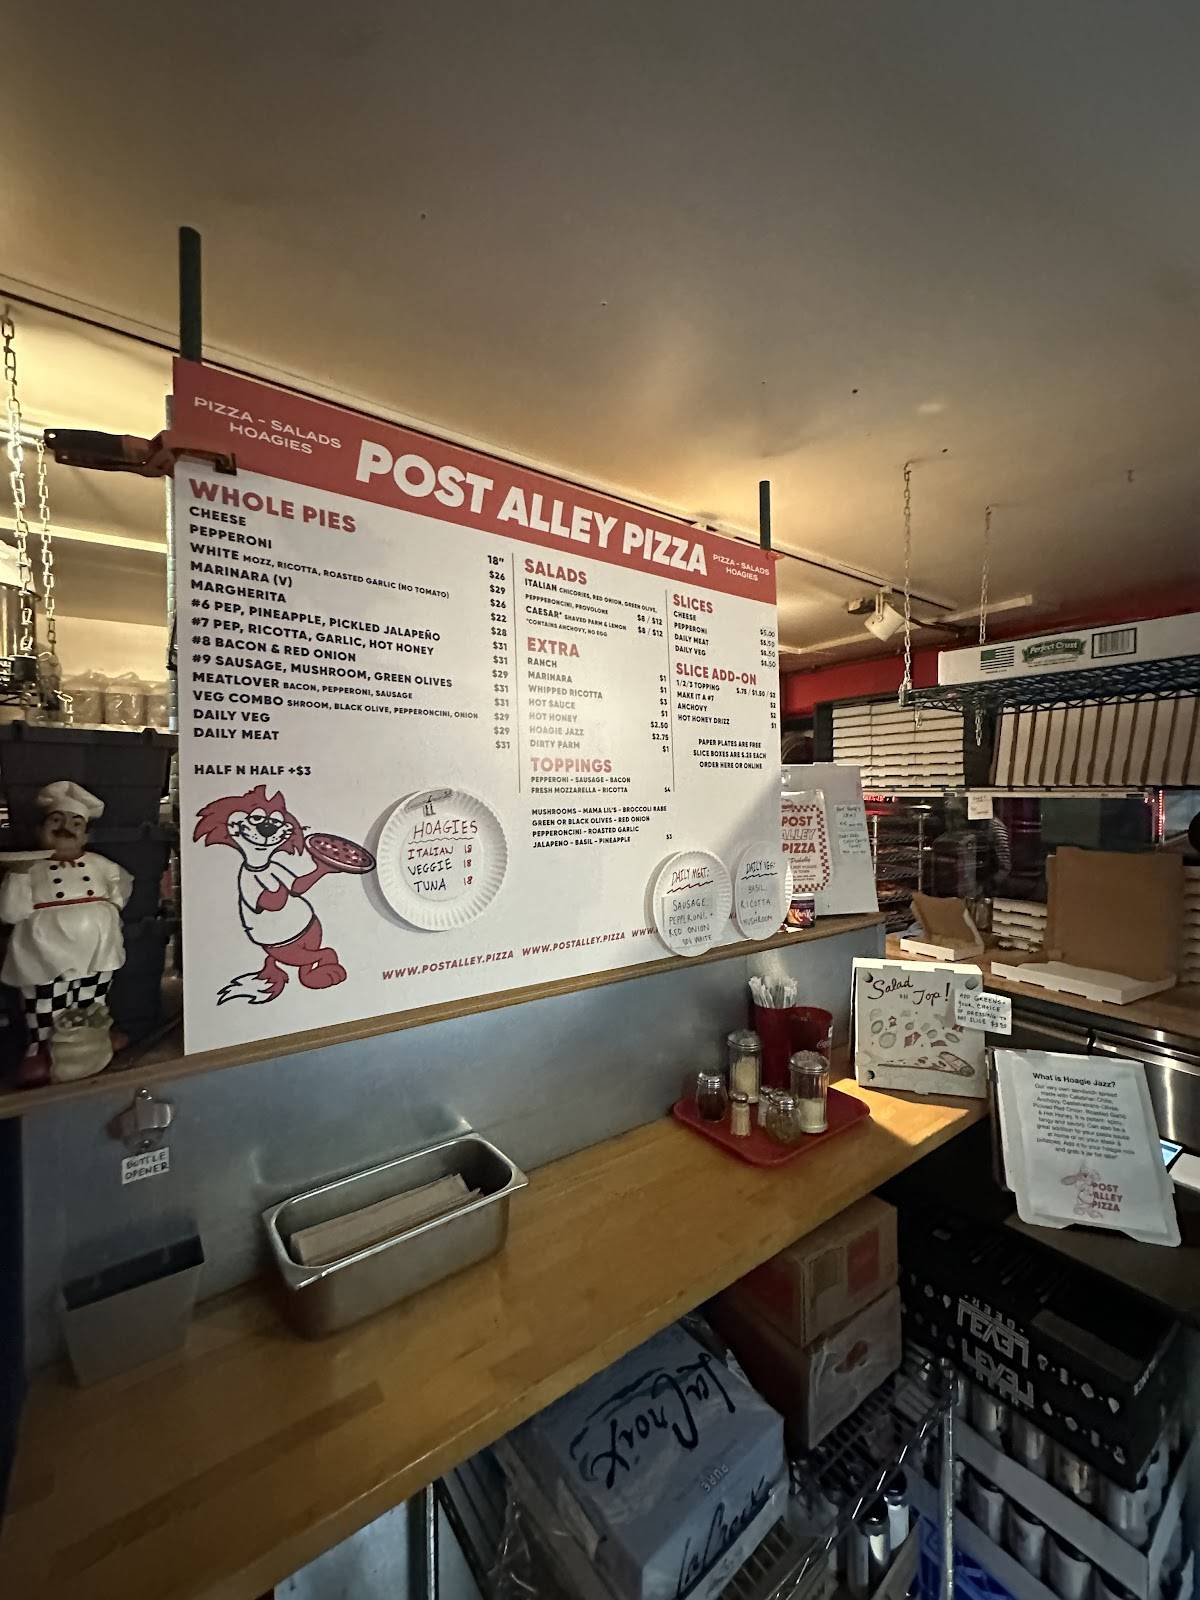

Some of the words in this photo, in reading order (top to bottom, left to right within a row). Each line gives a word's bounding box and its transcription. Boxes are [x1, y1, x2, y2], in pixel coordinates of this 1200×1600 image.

[194, 396, 252, 422] PIZZA
[271, 420, 342, 449] SALADS
[230, 422, 313, 454] HOAGIES
[189, 479, 294, 520] WHOLE
[303, 506, 357, 533] PIES
[356, 439, 493, 513] POST
[498, 486, 620, 548] ALLEY
[622, 522, 708, 577] PIZZA
[190, 506, 246, 526] CHEESE
[190, 524, 272, 549] PEPPERONI
[190, 542, 239, 560] WHITE
[277, 561, 321, 576] RICOTTA,
[323, 570, 363, 583] ROASTED
[366, 578, 396, 589] GARLIC
[524, 558, 587, 585] SALADS
[713, 554, 735, 566] PIZZA
[741, 563, 770, 576] SALADS
[191, 561, 269, 583] MARINARA
[274, 575, 293, 587] (V)
[489, 571, 505, 581] $26
[726, 567, 758, 581] HOAGIES
[191, 579, 286, 603] MARGHERITA
[490, 585, 505, 595] $29
[525, 578, 557, 591] ITALIAN
[490, 599, 506, 609] $26
[575, 603, 608, 615] PROVOLONE
[673, 594, 713, 614] SLICES
[192, 599, 210, 609] #6
[215, 602, 244, 616] PEP,
[250, 606, 325, 627] PINEAPPLE,
[329, 618, 379, 632] PICKLED
[384, 626, 440, 641] JALAPEÑO
[490, 613, 507, 623] $22
[564, 615, 586, 623] SHAVED
[609, 622, 626, 630] LEMON
[674, 611, 696, 621] CHEESE
[491, 627, 507, 637] $28
[674, 622, 707, 634] PEPPERONI
[192, 617, 209, 627] #7
[214, 619, 243, 633] PEP,
[248, 624, 312, 641] RICOTTA,
[316, 633, 366, 648] GARLIC,
[370, 640, 392, 650] HOT
[397, 644, 434, 655] HONEY
[675, 634, 691, 642] DAILY
[192, 636, 211, 646] #8
[215, 638, 266, 652] BACON
[284, 646, 309, 656] RED
[314, 649, 356, 662] ONION
[493, 641, 507, 650] $31
[527, 637, 580, 657] EXTRA
[1030, 644, 1054, 653] Perfect
[493, 656, 508, 664] $31
[528, 658, 557, 668] RANCH
[193, 655, 211, 664] #9
[216, 656, 287, 673] SAUSAGE,
[291, 663, 371, 681] MUSHROOM,
[374, 672, 411, 683] GREEN
[415, 676, 453, 687] OLIVES
[528, 671, 572, 683] MARINARA
[677, 663, 709, 678] SLICE
[712, 668, 756, 685] ADD-ON
[193, 672, 279, 688] MEATLOVER
[376, 690, 413, 699] SAUSAGE
[529, 685, 567, 696] WHIPPED
[570, 689, 602, 699] RICOTTA
[694, 682, 719, 691] TOPPING
[193, 691, 224, 701] VEG
[229, 693, 283, 705] COMBO
[529, 698, 547, 706] HOT
[549, 700, 575, 709] SAUCE
[678, 703, 707, 711] ANCHOVY
[193, 709, 237, 720] DAILY
[242, 712, 270, 722] VEG
[529, 712, 547, 720] HOT
[549, 714, 577, 722] HONEY
[194, 728, 237, 738] DAILY
[242, 730, 279, 740] MEAT
[530, 726, 562, 735] HOAGIE
[565, 727, 584, 736] JAZZ
[530, 740, 555, 748] DIRTY
[558, 740, 580, 748] PARM
[195, 765, 231, 775] HALF
[237, 765, 245, 775] N
[251, 765, 284, 775] HALF
[289, 766, 311, 776] +$3
[530, 757, 612, 773] TOPPINGS
[782, 816, 812, 826] POST
[414, 820, 478, 839] HOAGIES
[408, 846, 453, 860] ITALIAN
[465, 845, 472, 853] 18
[783, 843, 815, 853] PIZZA
[408, 858, 452, 875] VEGGIE
[464, 860, 471, 868] 18
[746, 861, 762, 874] DAILY
[672, 868, 690, 885] DAILY
[414, 878, 446, 892] TUNA
[464, 876, 472, 885] 18
[673, 898, 705, 912] SAUSAGE
[669, 928, 681, 938] RED
[688, 924, 710, 934] ONION
[382, 950, 514, 980] WWW.POSTALLEY.PIZZA
[522, 932, 625, 956] WWW.POSTALLEY.PIZZA
[867, 976, 913, 1000] Salad
[1064, 1076, 1091, 1085] Hoagie
[1094, 1080, 1115, 1088] Jazz?
[127, 1152, 165, 1169] BOTTLE
[125, 1162, 168, 1179] OPENER
[1092, 1184, 1118, 1192] POST
[1090, 1192, 1122, 1202] ALLEY
[1092, 1202, 1120, 1211] PIZZA
[579, 1352, 735, 1489] LaCroix
[702, 1463, 729, 1492] PURE
